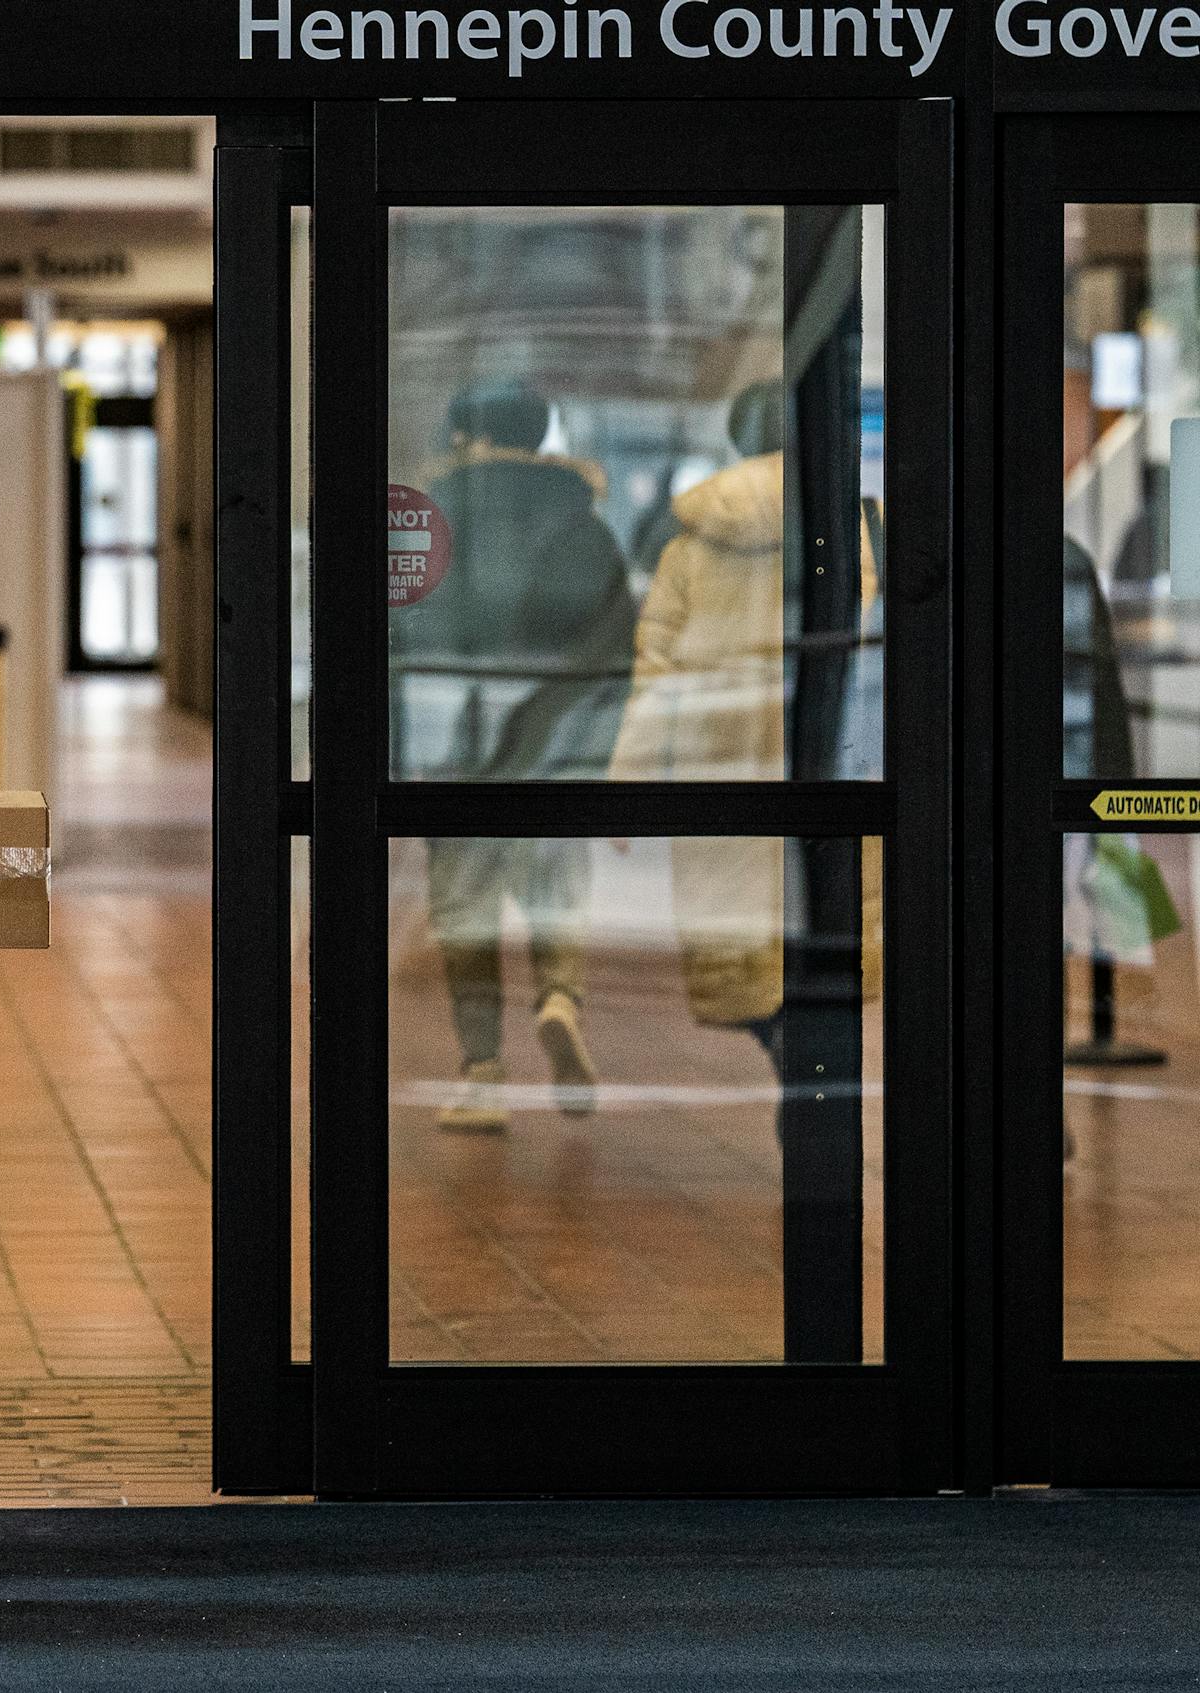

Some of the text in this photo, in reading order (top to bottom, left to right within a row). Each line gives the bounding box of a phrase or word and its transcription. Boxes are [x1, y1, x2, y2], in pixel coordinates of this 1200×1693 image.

[239, 0, 1200, 78] Hennepin County Gove
[388, 510, 432, 528] NOT
[1107, 796, 1200, 815] AUTOMATIC D
